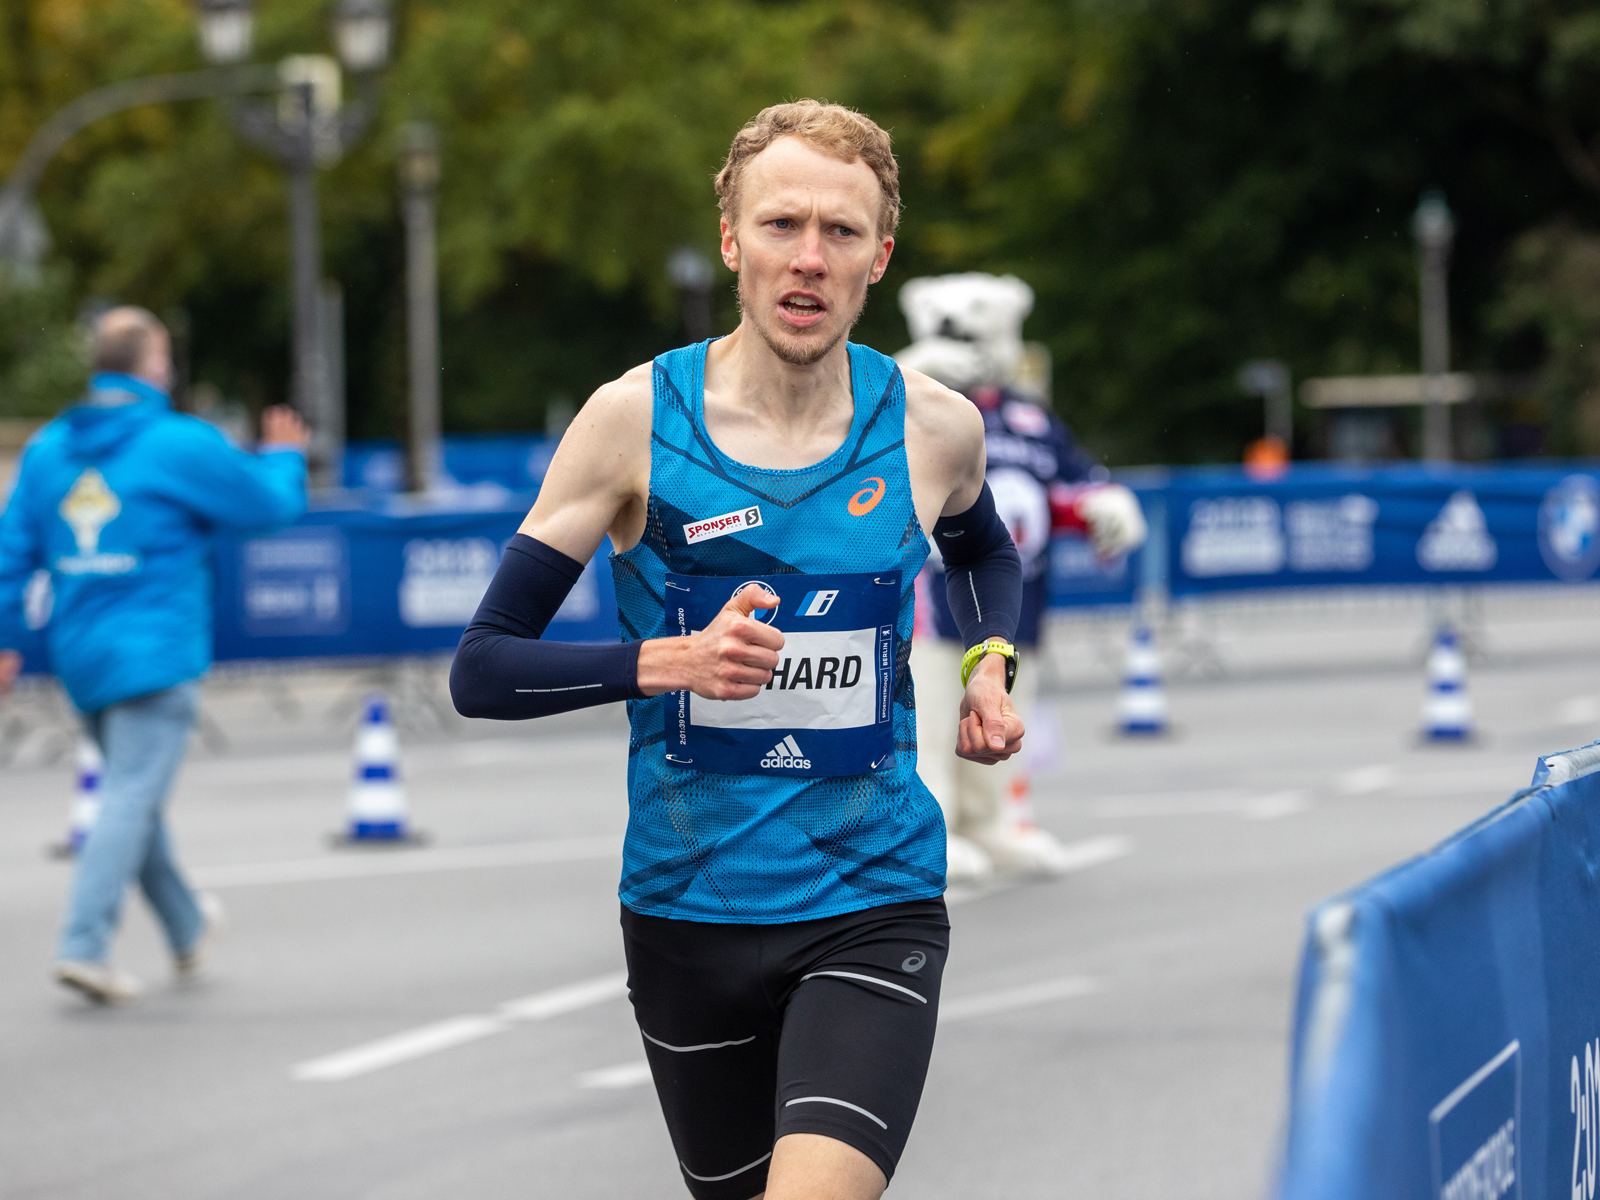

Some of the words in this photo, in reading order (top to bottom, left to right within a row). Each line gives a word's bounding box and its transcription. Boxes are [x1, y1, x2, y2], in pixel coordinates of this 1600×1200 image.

[688, 515, 740, 539] SPONSER
[760, 655, 862, 690] HARD
[760, 756, 812, 770] adidas
